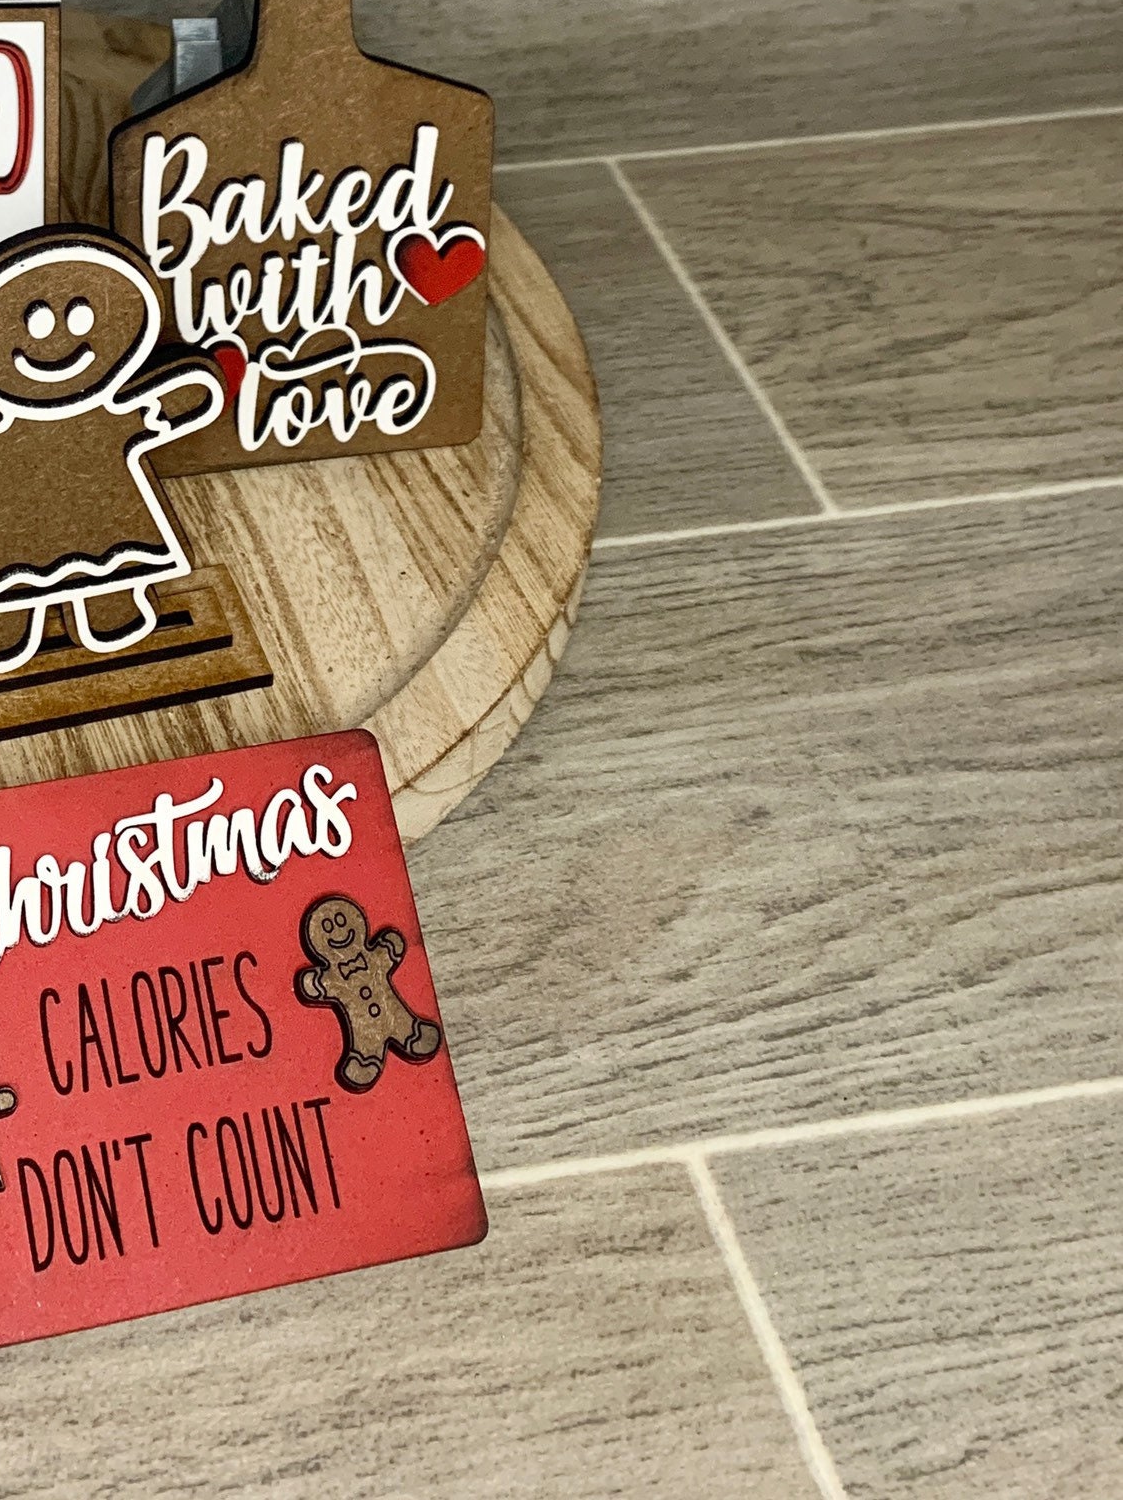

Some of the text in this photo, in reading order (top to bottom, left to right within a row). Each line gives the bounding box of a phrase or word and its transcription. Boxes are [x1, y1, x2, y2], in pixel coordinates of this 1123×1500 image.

[141, 120, 455, 279] Baked
[173, 233, 407, 344] with
[237, 323, 437, 453] love
[38, 949, 274, 1097] CALORIES
[16, 1098, 342, 1275] DON'T COUNT
